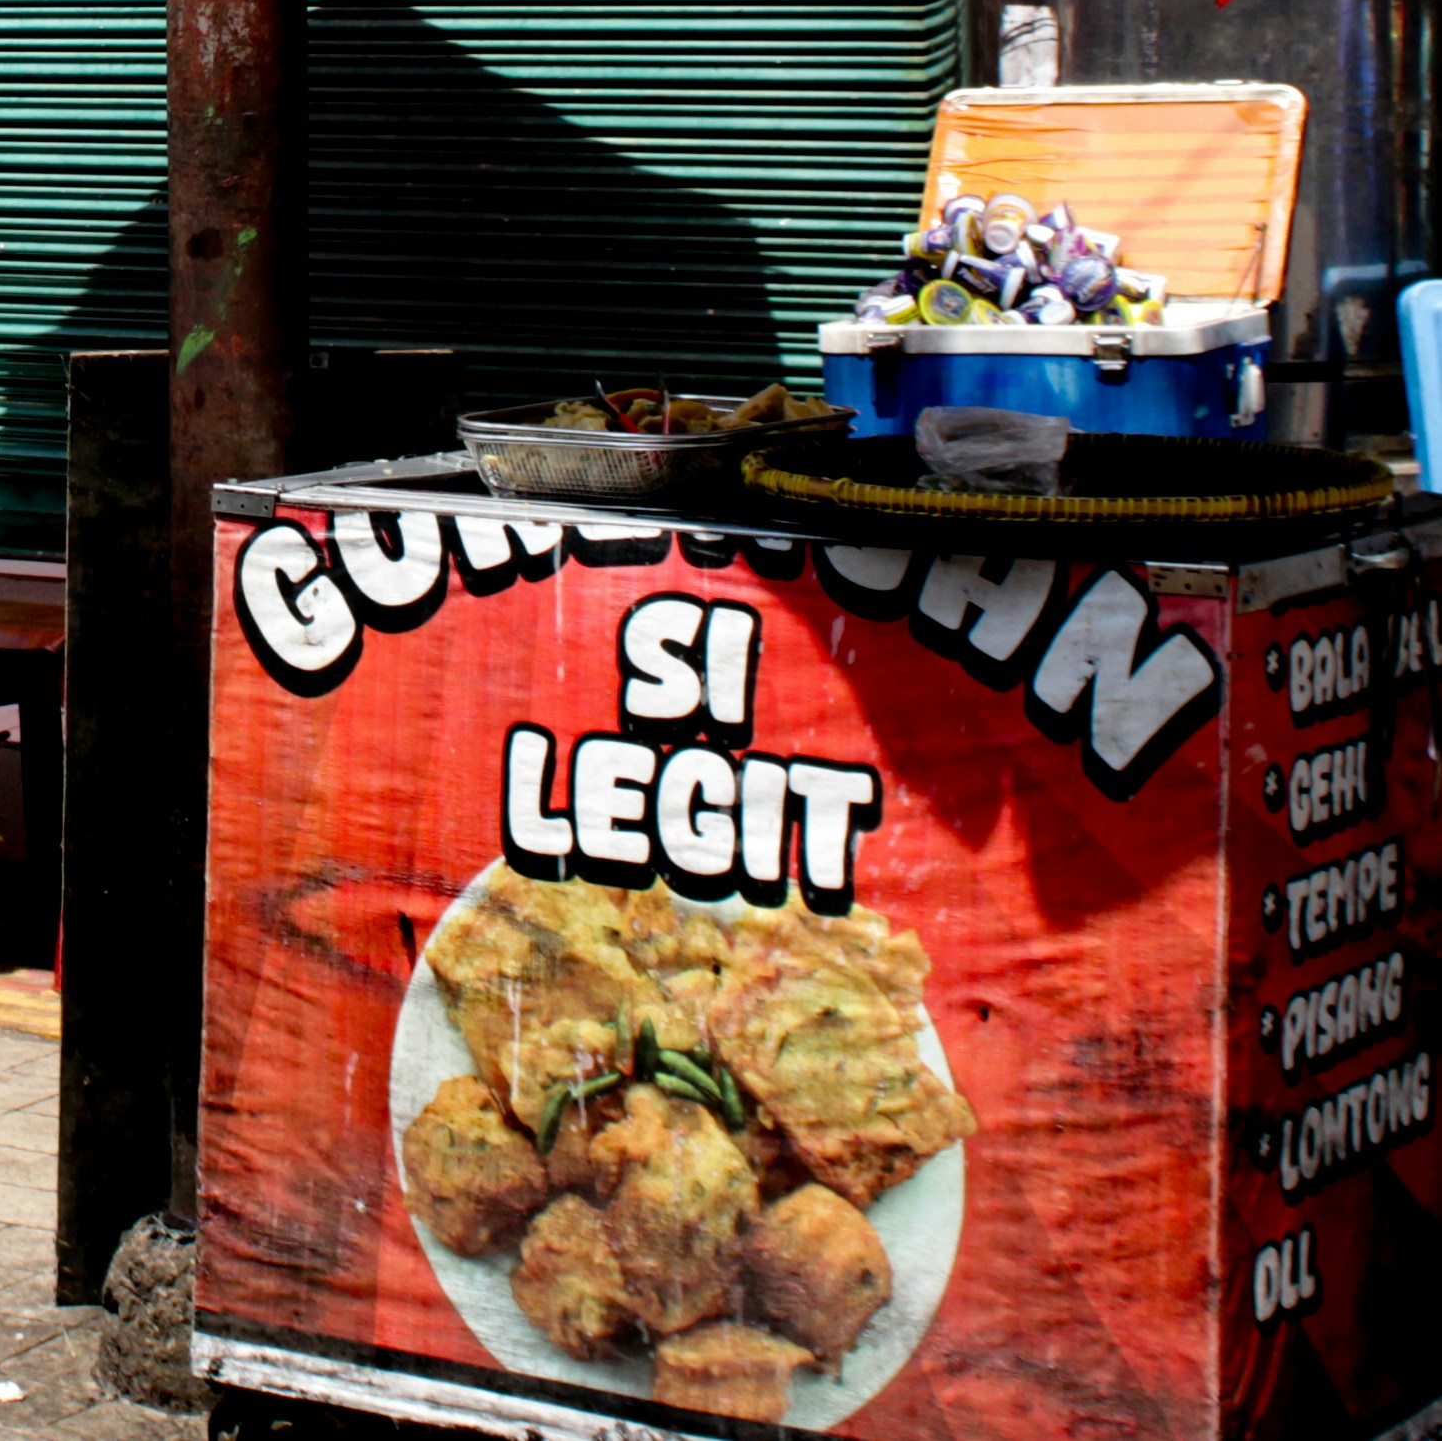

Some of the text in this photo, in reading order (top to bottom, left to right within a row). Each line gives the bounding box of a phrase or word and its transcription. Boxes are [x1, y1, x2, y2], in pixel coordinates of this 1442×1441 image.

[621, 598, 757, 726] SI
[1289, 624, 1371, 713] BALA
[507, 727, 873, 893] LEGIT
[1286, 842, 1398, 950] TEMPE
[1281, 951, 1404, 1071] PISANG
[1280, 1051, 1430, 1191] LONTONG
